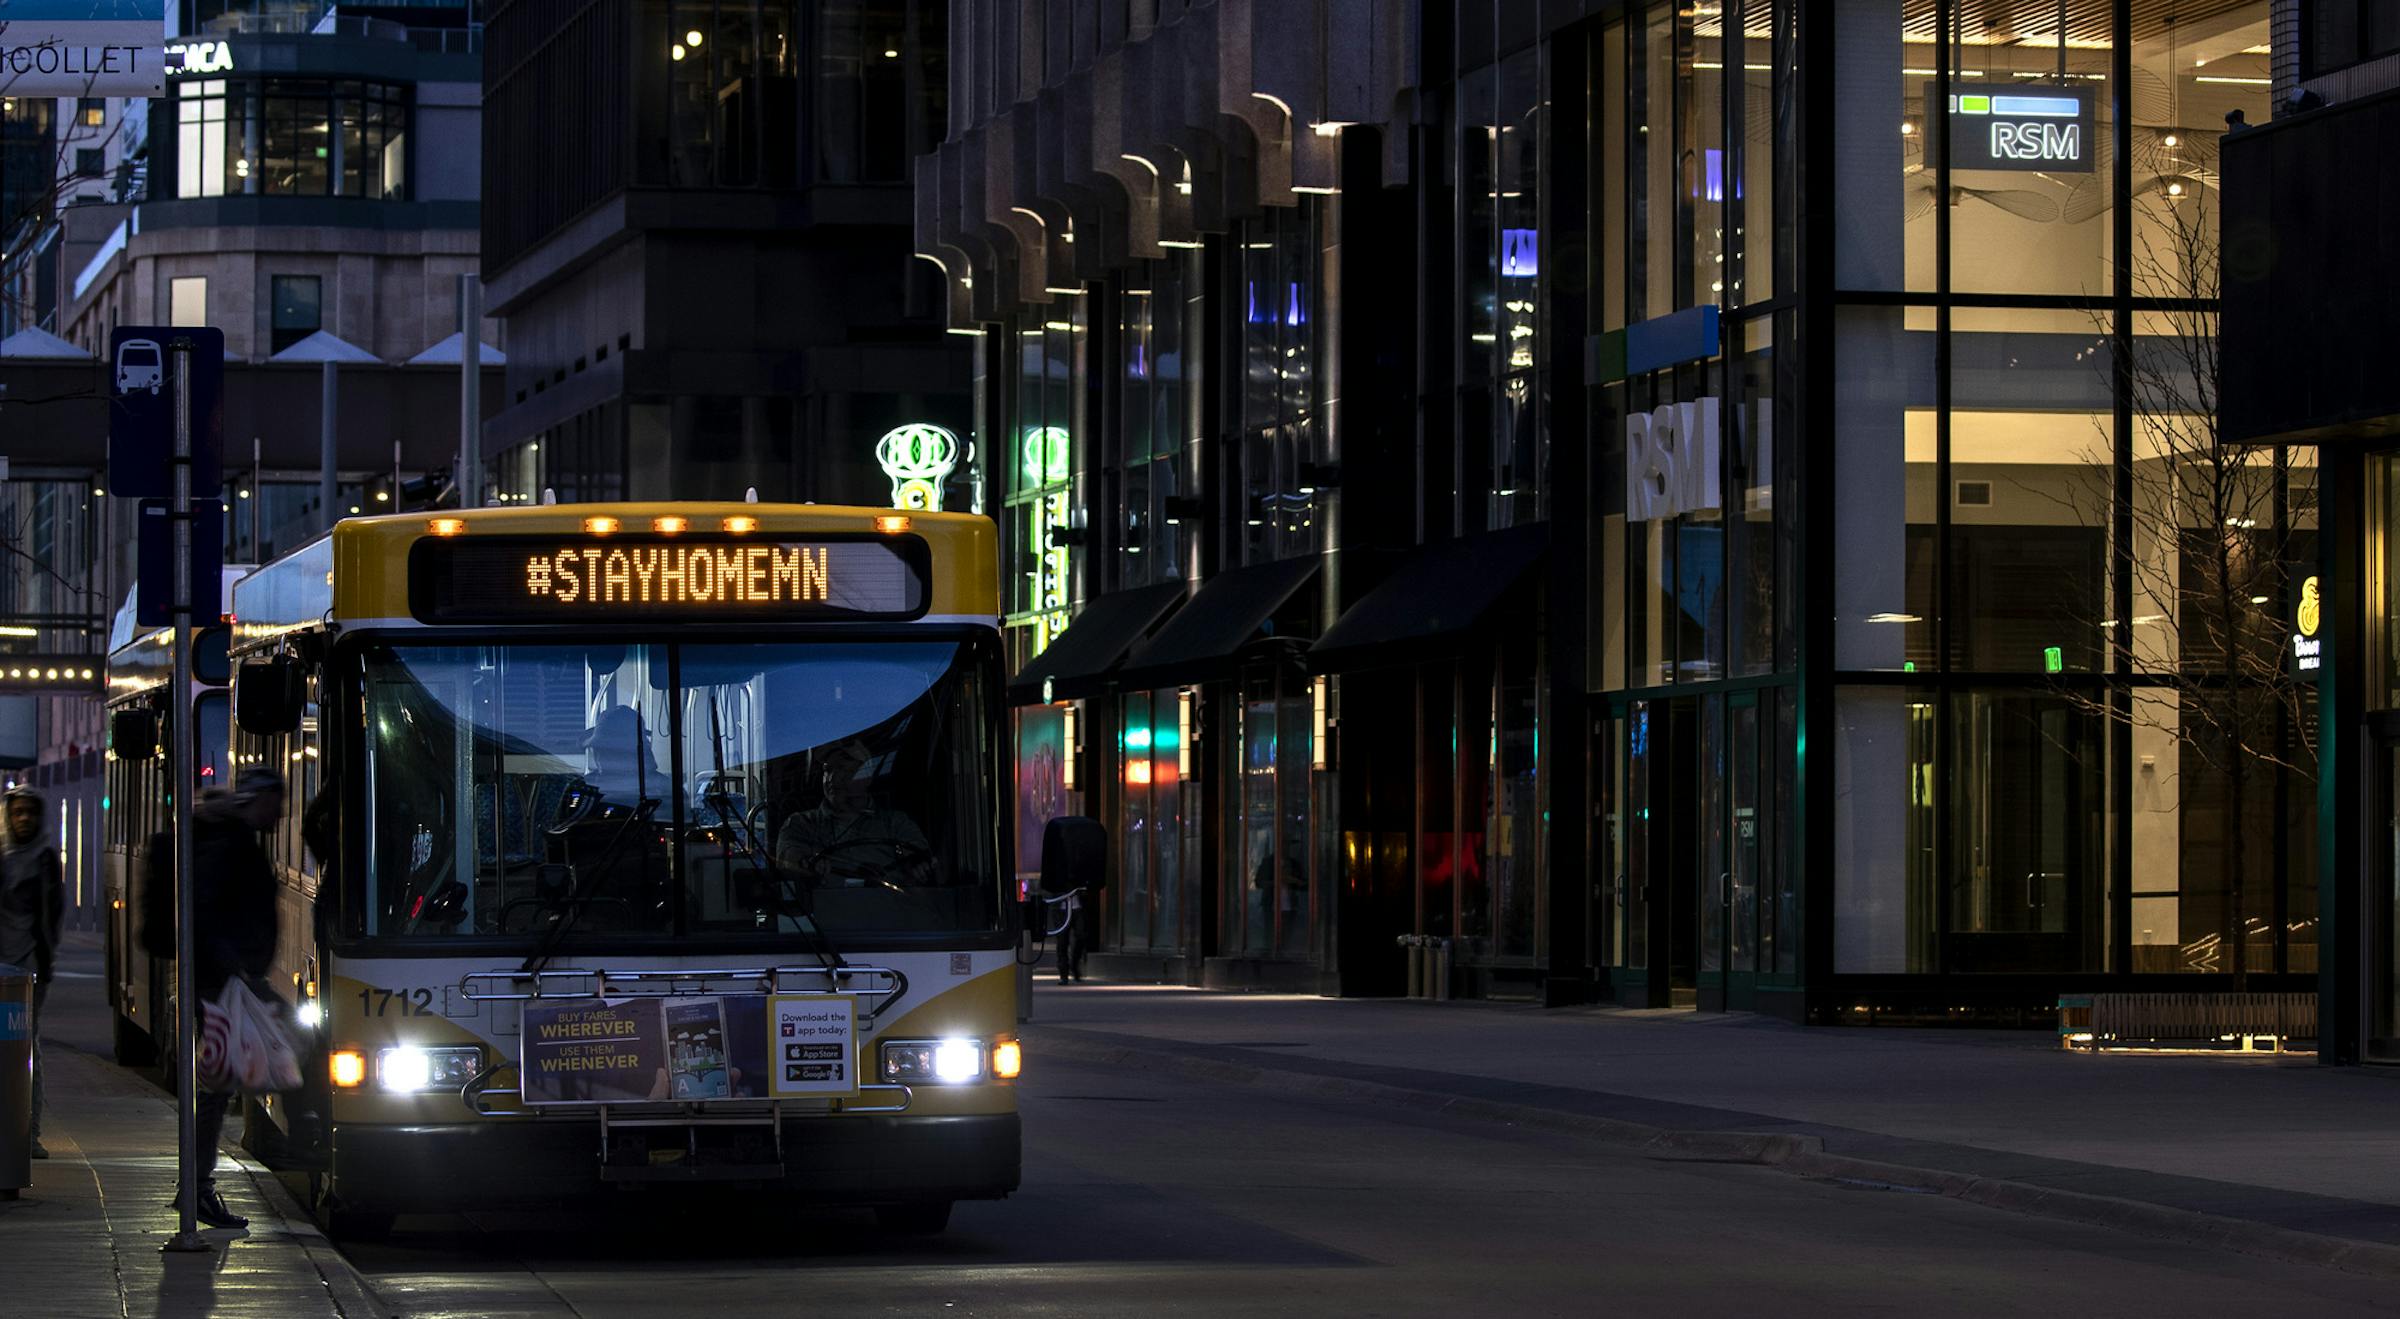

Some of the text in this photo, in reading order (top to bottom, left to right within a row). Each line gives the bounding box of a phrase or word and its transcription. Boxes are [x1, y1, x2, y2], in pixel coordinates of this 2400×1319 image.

[1991, 121, 2080, 161] RSM
[1626, 396, 1720, 522] RSM
[526, 546, 828, 602] #STAYHOMEMN
[358, 988, 434, 1018] 1712
[558, 1010, 617, 1023] BUY FARES
[782, 1012, 846, 1022] Download the
[540, 1021, 636, 1039] WHEREVER
[798, 1027, 815, 1036] app
[818, 1026, 847, 1036] today:
[559, 1044, 615, 1056] USE THEM
[803, 1049, 838, 1060] App Store
[540, 1055, 639, 1073] WHENEVER
[802, 1070, 826, 1079] Google
